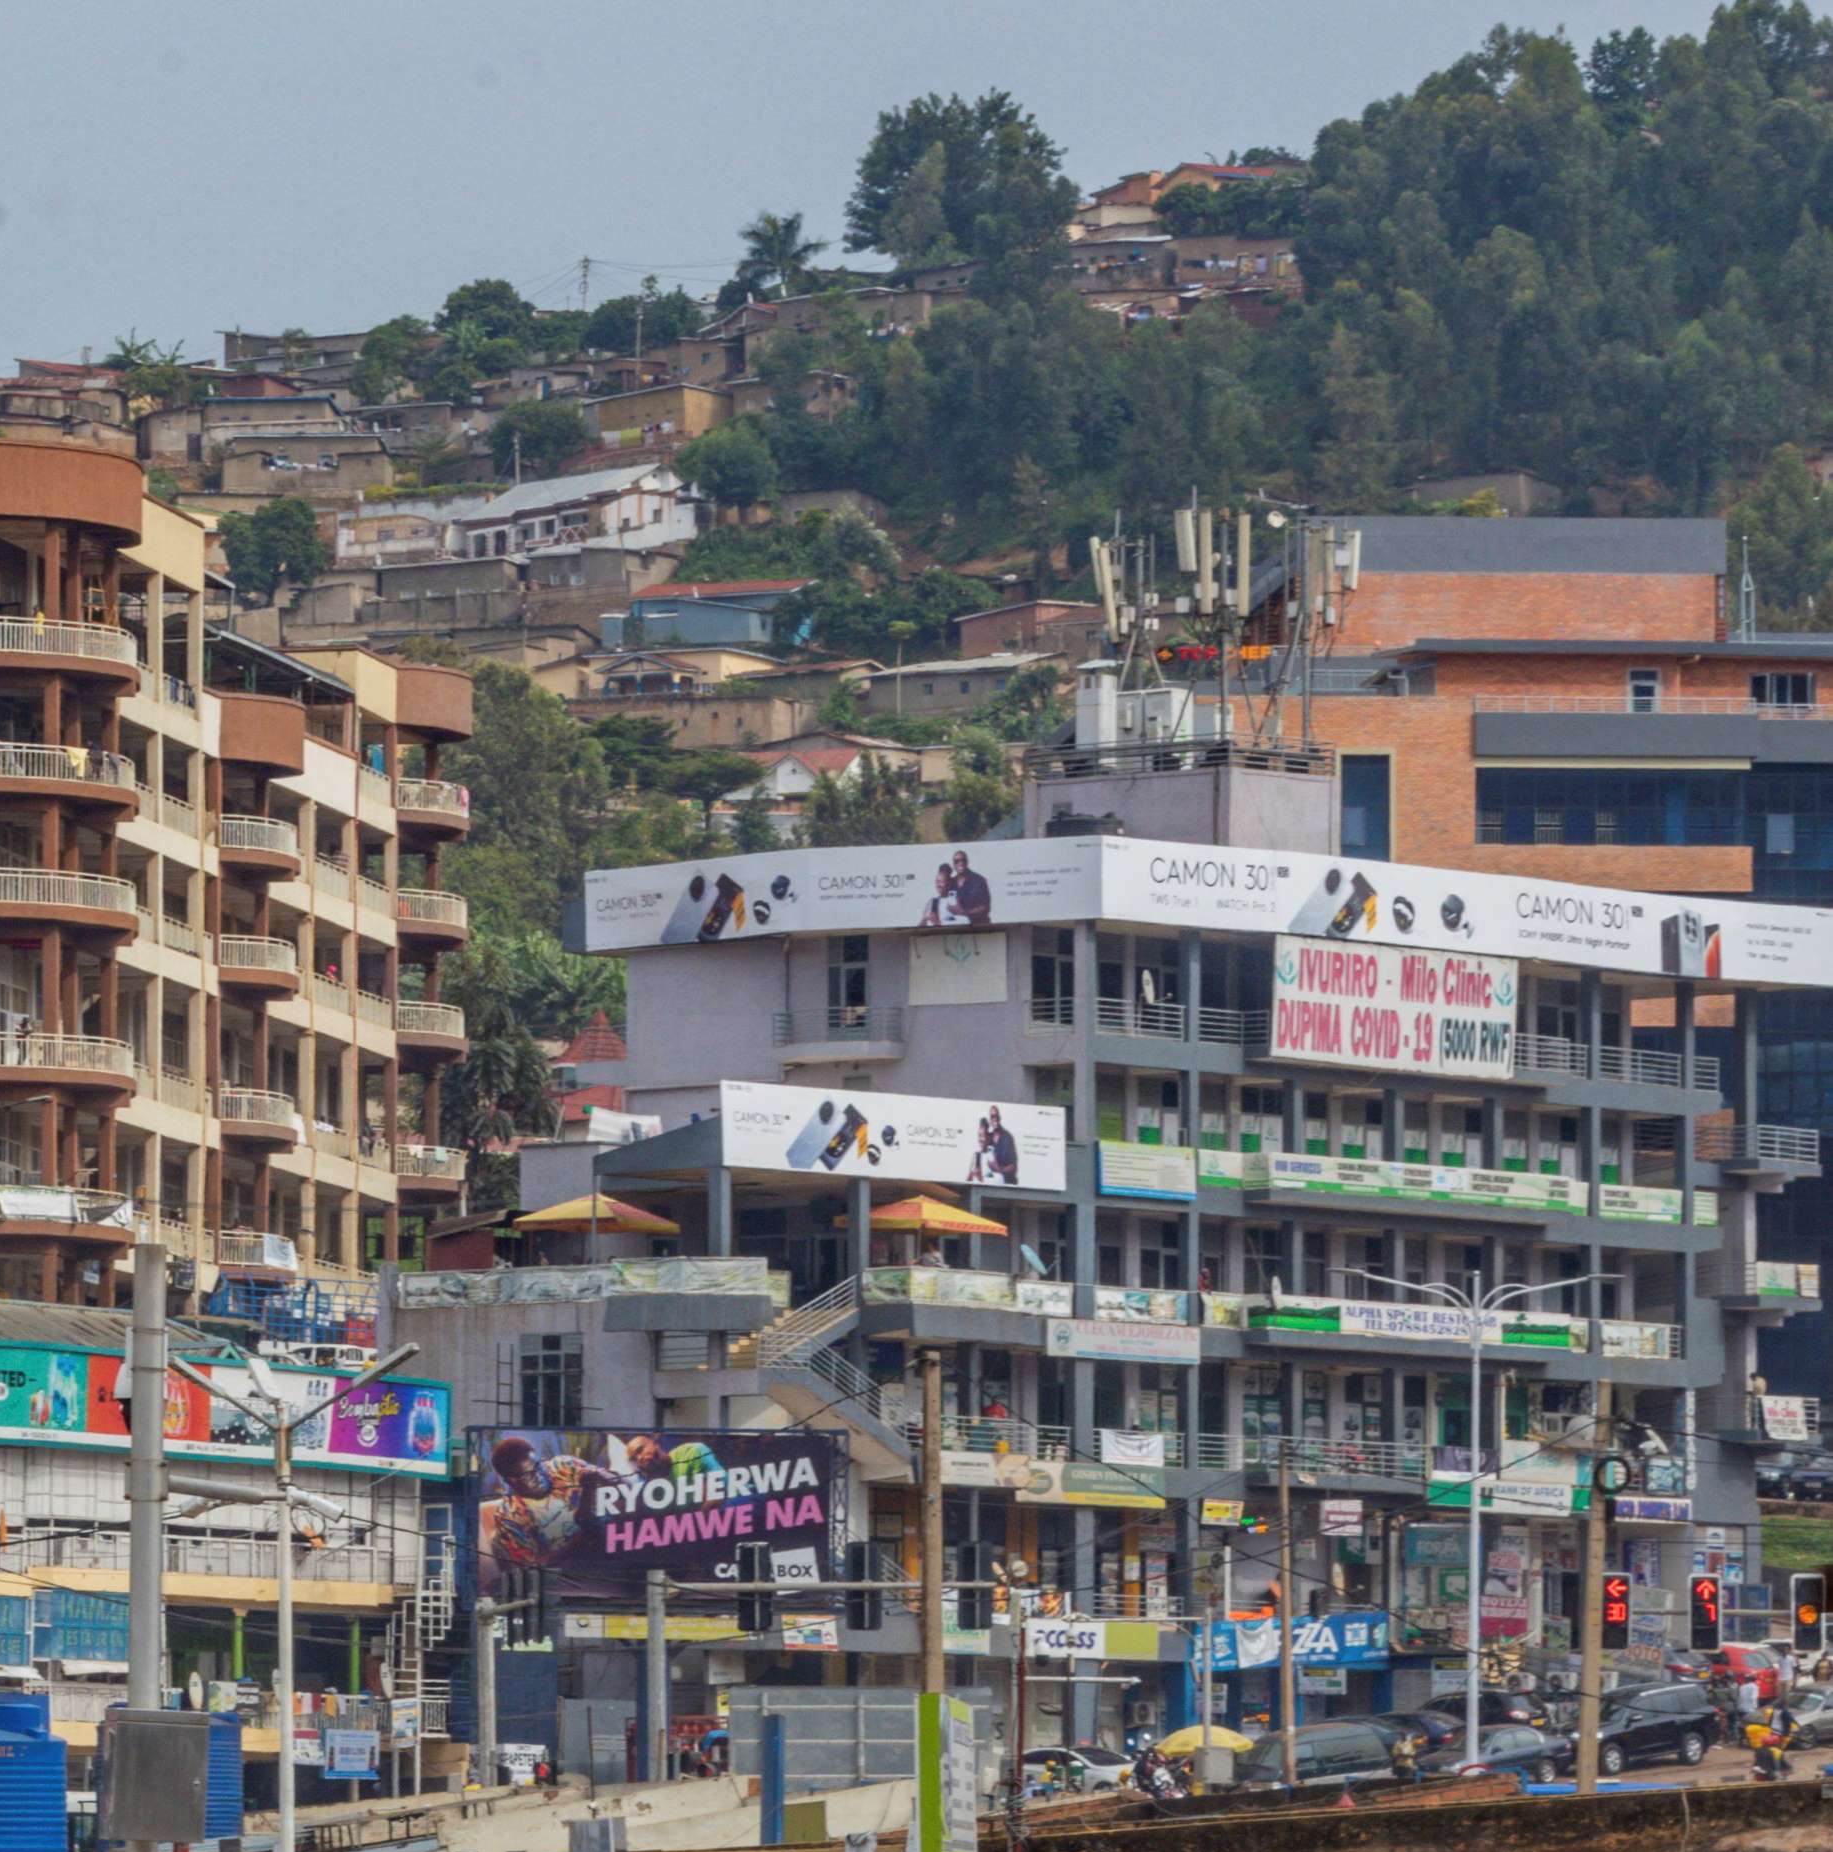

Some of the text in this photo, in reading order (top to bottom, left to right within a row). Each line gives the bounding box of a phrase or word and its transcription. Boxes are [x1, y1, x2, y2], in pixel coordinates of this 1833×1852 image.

[818, 875, 877, 891] CAMON
[1150, 857, 1268, 891] CAMON 30
[596, 898, 638, 912] CAMON
[1516, 892, 1624, 929] CAMON 30
[1299, 948, 1377, 998] IVURIRO
[1443, 957, 1492, 1009] Clinic
[1277, 998, 1342, 1055] DUPIMA
[1351, 1004, 1400, 1060] COVID
[1414, 1013, 1432, 1062] 19
[1346, 1306, 1381, 1319] ALPHA
[595, 1457, 819, 1517] RYOHERWA
[1493, 1486, 1517, 1495] BANK
[1534, 1486, 1564, 1498] AFRICA
[605, 1494, 824, 1553] HAMWE NA
[777, 1564, 813, 1579] BOX
